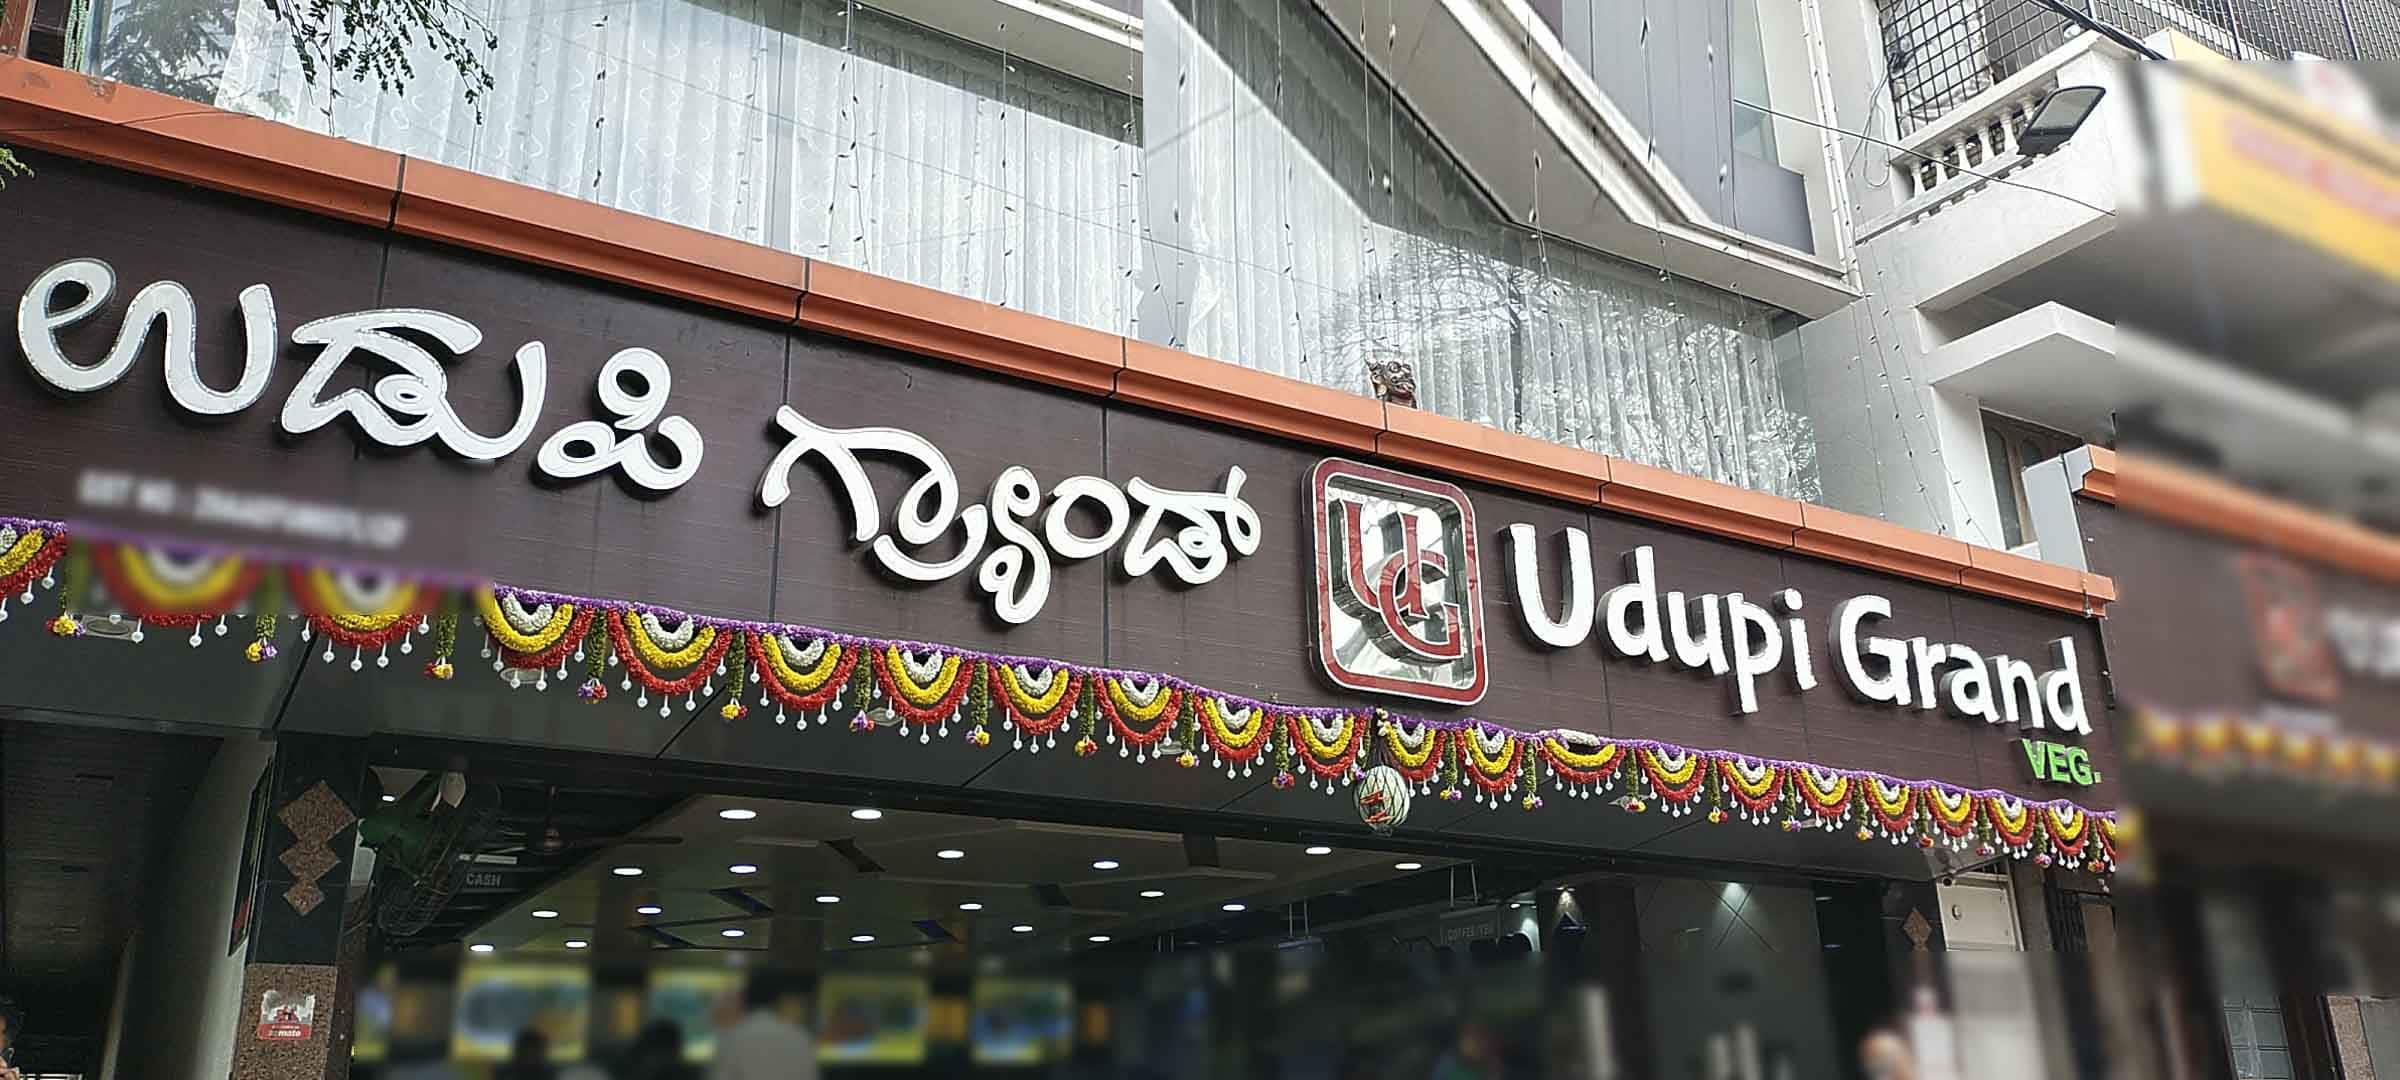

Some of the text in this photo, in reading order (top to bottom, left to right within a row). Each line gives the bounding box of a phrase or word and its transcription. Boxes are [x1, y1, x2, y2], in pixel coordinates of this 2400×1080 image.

[18, 257, 704, 491] ಉಡುಪಿ
[1508, 522, 2094, 736] Udupi Grand
[2021, 737, 2102, 786] VEG.
[466, 872, 502, 887] CASH
